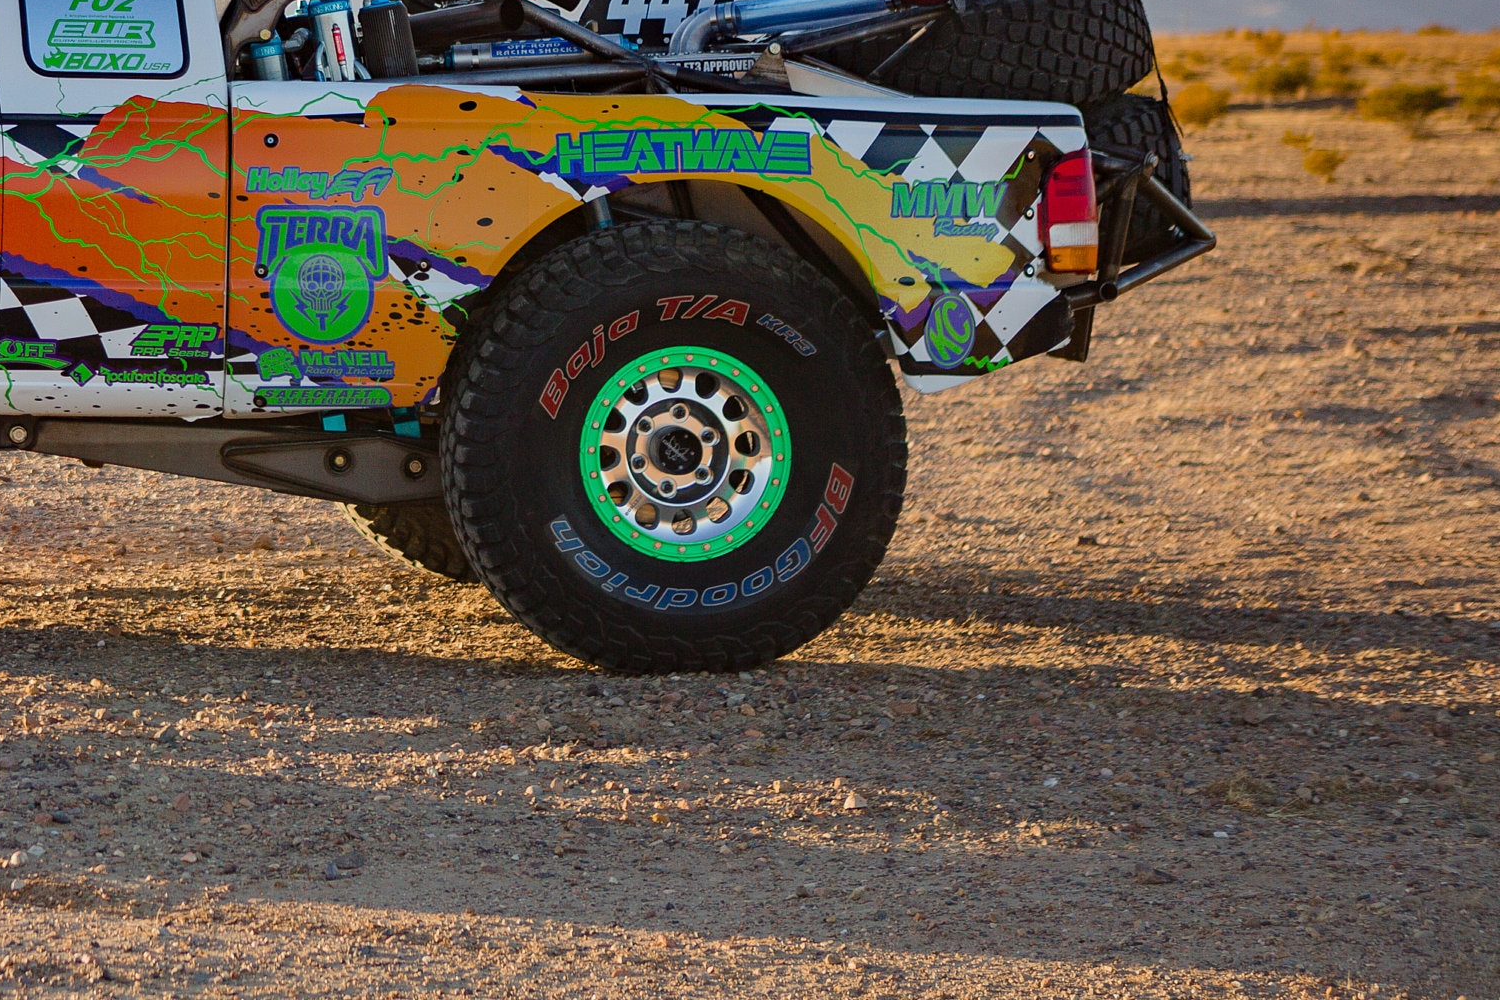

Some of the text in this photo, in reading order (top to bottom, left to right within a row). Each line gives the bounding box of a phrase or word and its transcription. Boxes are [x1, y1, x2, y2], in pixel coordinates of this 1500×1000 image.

[54, 21, 150, 39] EWR
[496, 46, 579, 56] RACING SHOCKS
[507, 42, 561, 50] OFF-ROAD
[63, 53, 172, 71] BOXO USA
[703, 58, 754, 73] APPROVED
[556, 129, 812, 176] HEATWAVE
[247, 166, 394, 202] Holley EFI
[891, 182, 1009, 218] MMW
[933, 217, 1000, 243] Racing
[265, 216, 378, 271] TERRA
[133, 324, 218, 348] PRP
[928, 300, 972, 361] KC
[132, 346, 210, 358] PRP Seats
[538, 294, 818, 420] Baja T/A KR3
[100, 366, 208, 387] Rockford Fosgate
[304, 365, 394, 376] Racing Inc.com
[264, 389, 374, 398] SAFECRAFT
[548, 462, 855, 611] BFGoodrich
